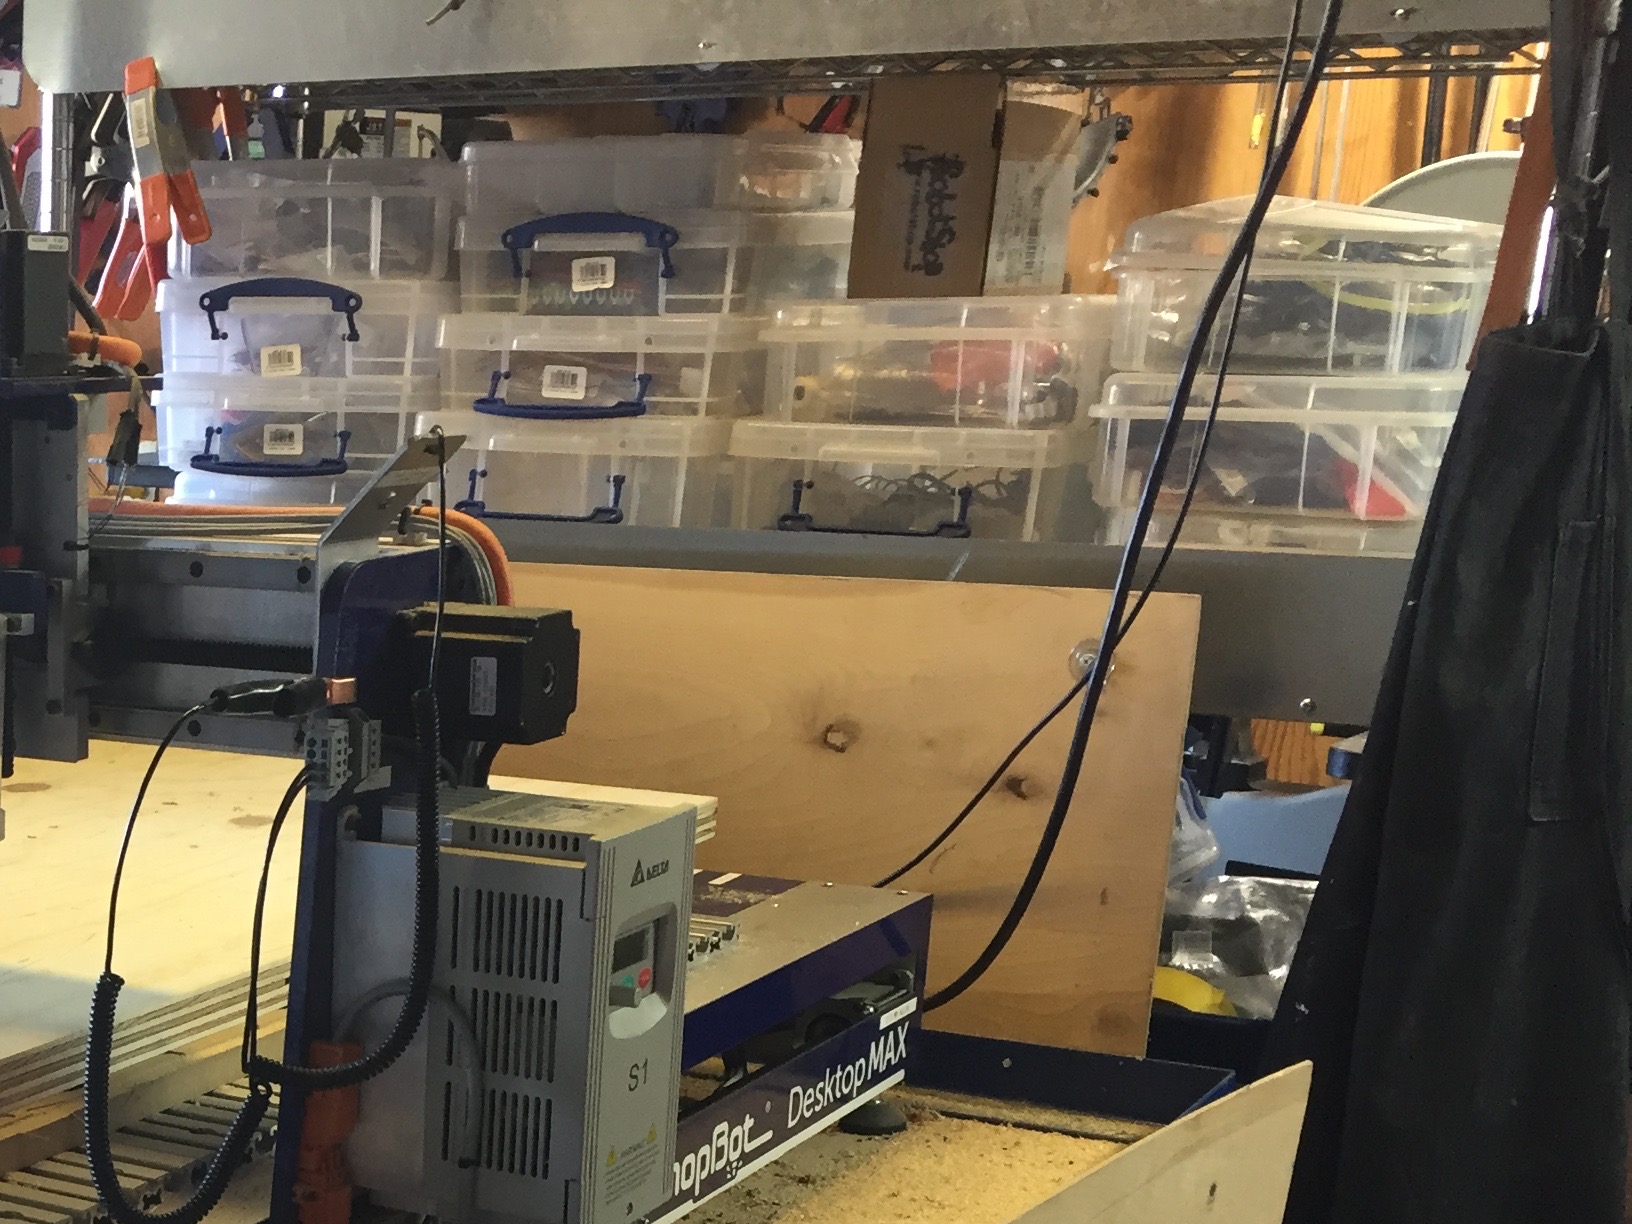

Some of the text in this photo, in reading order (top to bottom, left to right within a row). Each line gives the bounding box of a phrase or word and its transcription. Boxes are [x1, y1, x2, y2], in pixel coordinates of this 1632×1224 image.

[628, 1058, 648, 1092] S1
[788, 1021, 910, 1129] Desktop MAX
